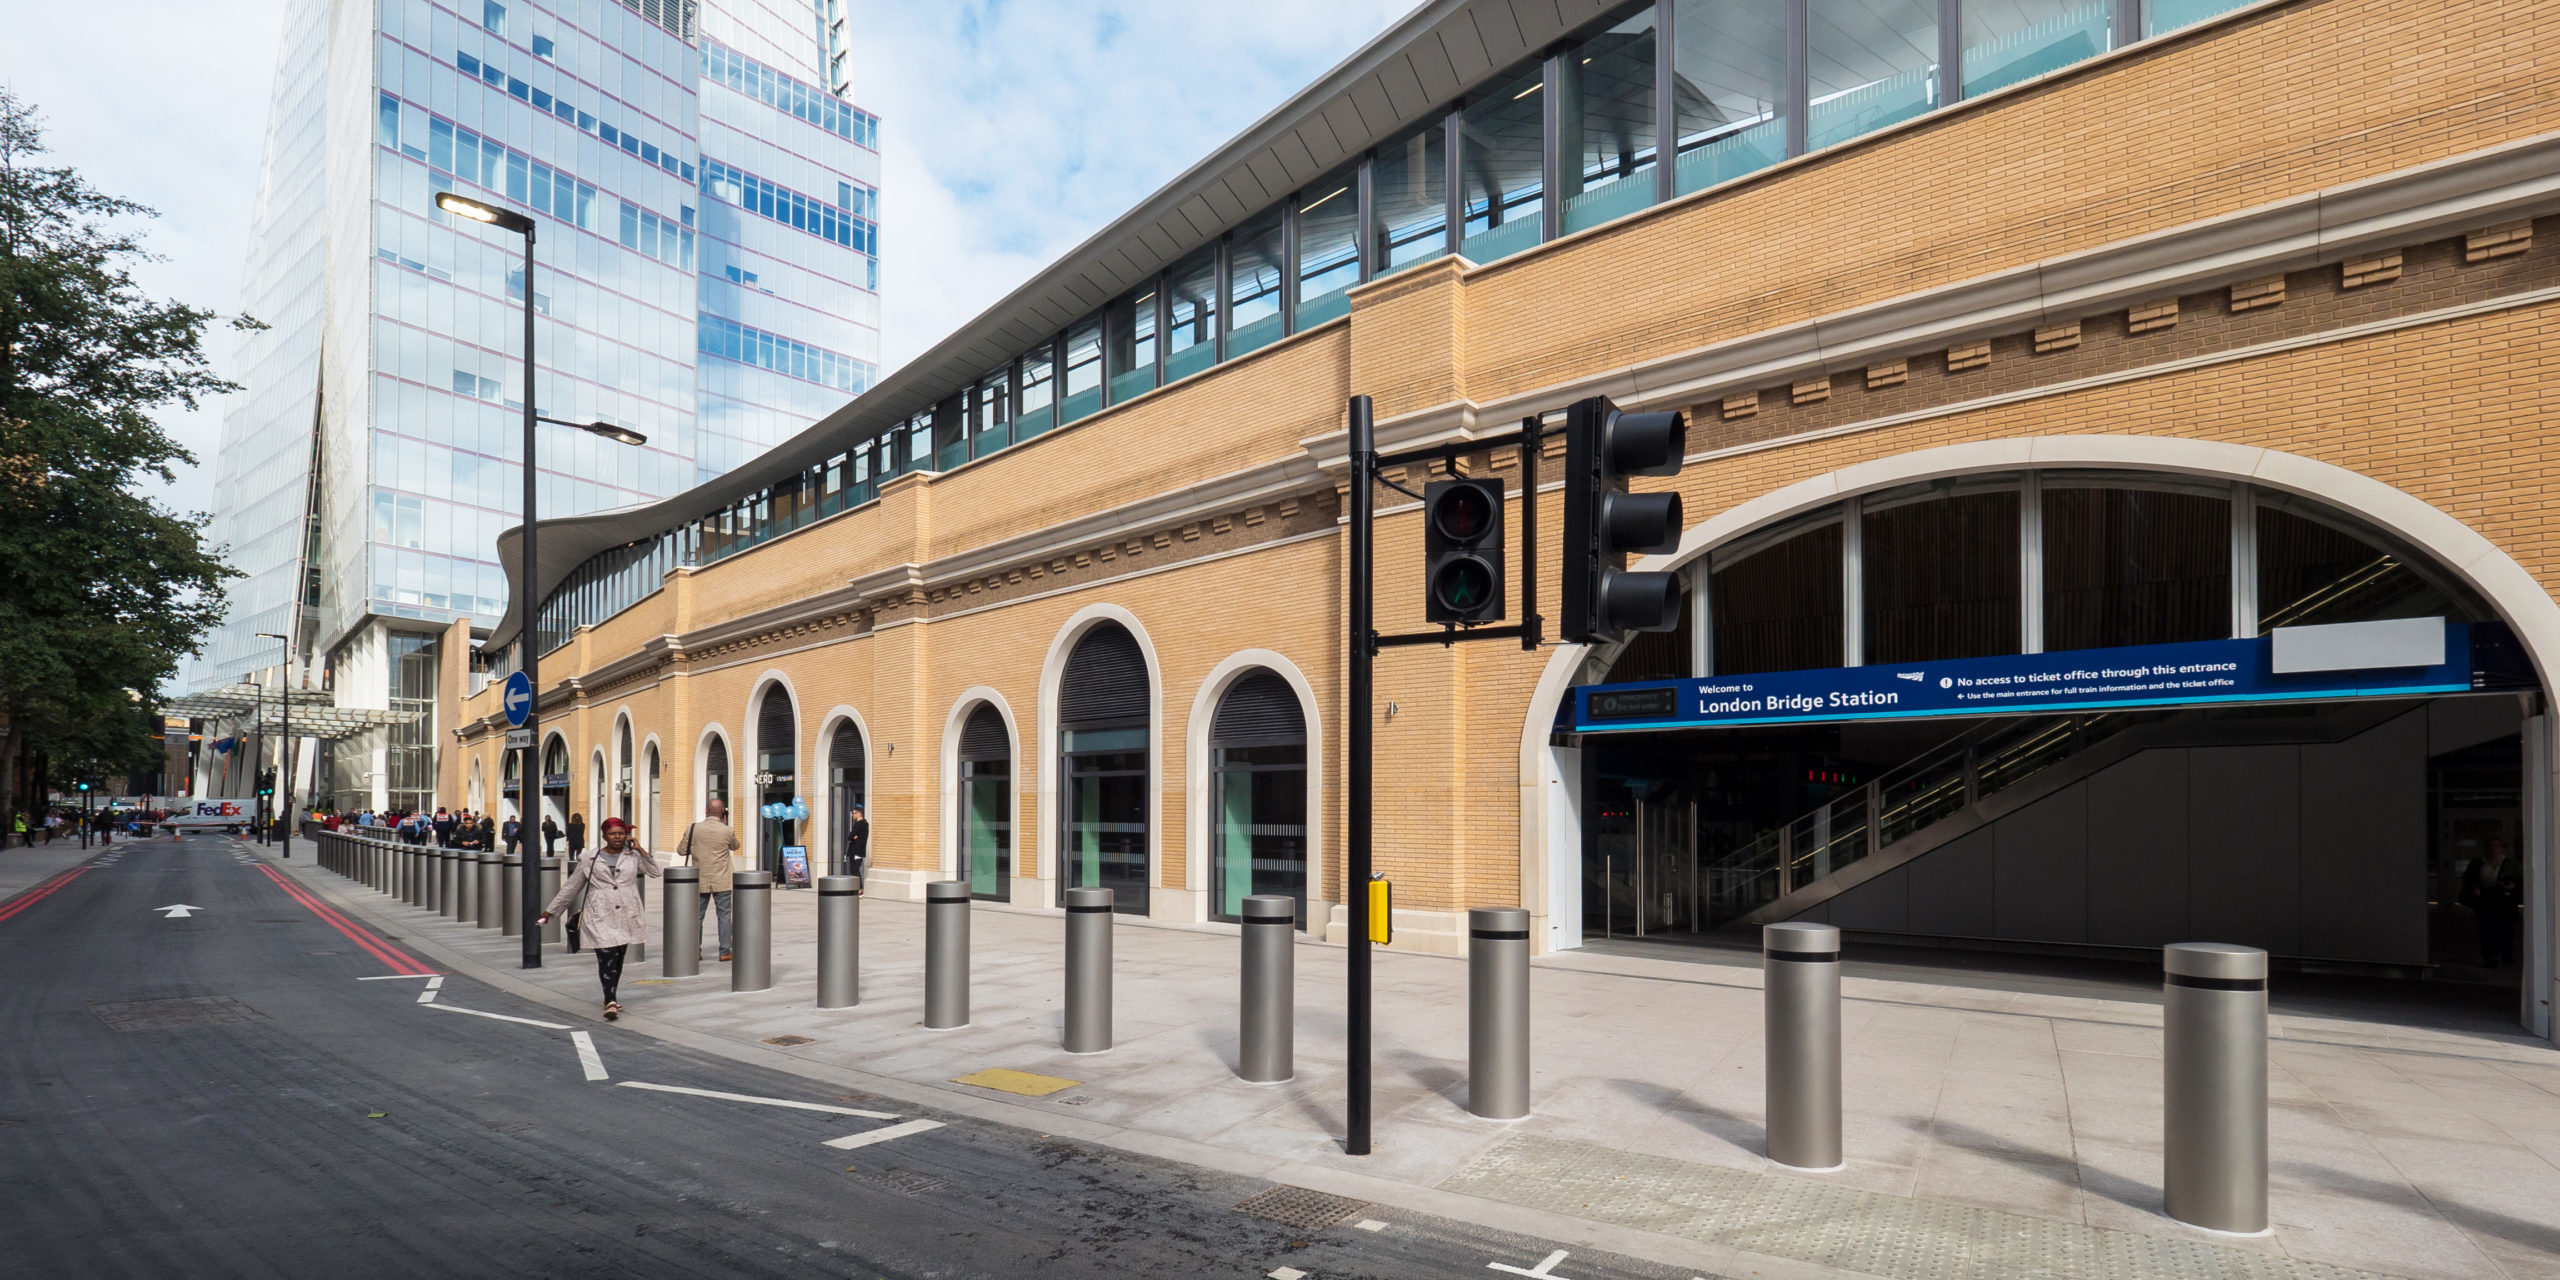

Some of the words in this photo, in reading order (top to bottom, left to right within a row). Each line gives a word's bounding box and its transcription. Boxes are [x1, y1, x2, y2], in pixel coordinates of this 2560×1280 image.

[1957, 677, 1973, 687] No
[1975, 676, 2011, 686] access
[2013, 675, 2026, 684] to
[2028, 672, 2061, 682] ticket
[2063, 670, 2099, 681] office
[2101, 666, 2150, 679] through
[2152, 664, 2177, 675] this
[2179, 662, 2237, 674] entrance
[1699, 685, 1741, 694] Welcome
[1742, 683, 1753, 692] to
[1967, 692, 1981, 700] Use
[1996, 690, 2015, 698] main
[2016, 689, 2049, 697] entrance
[2064, 686, 2077, 695] full
[2078, 684, 2098, 693] train
[2099, 683, 2147, 693] information
[2148, 682, 2164, 690] and
[2166, 681, 2180, 689] the
[2181, 680, 2206, 688] ticket
[2207, 678, 2235, 687] office
[1641, 702, 1660, 710] enter
[1700, 697, 1761, 714] London
[1766, 693, 1824, 712] Bridge
[1829, 690, 1899, 707] Station
[507, 735, 518, 744] One
[519, 734, 530, 745] way
[754, 774, 773, 785] NERO
[197, 802, 242, 816] FedEx
